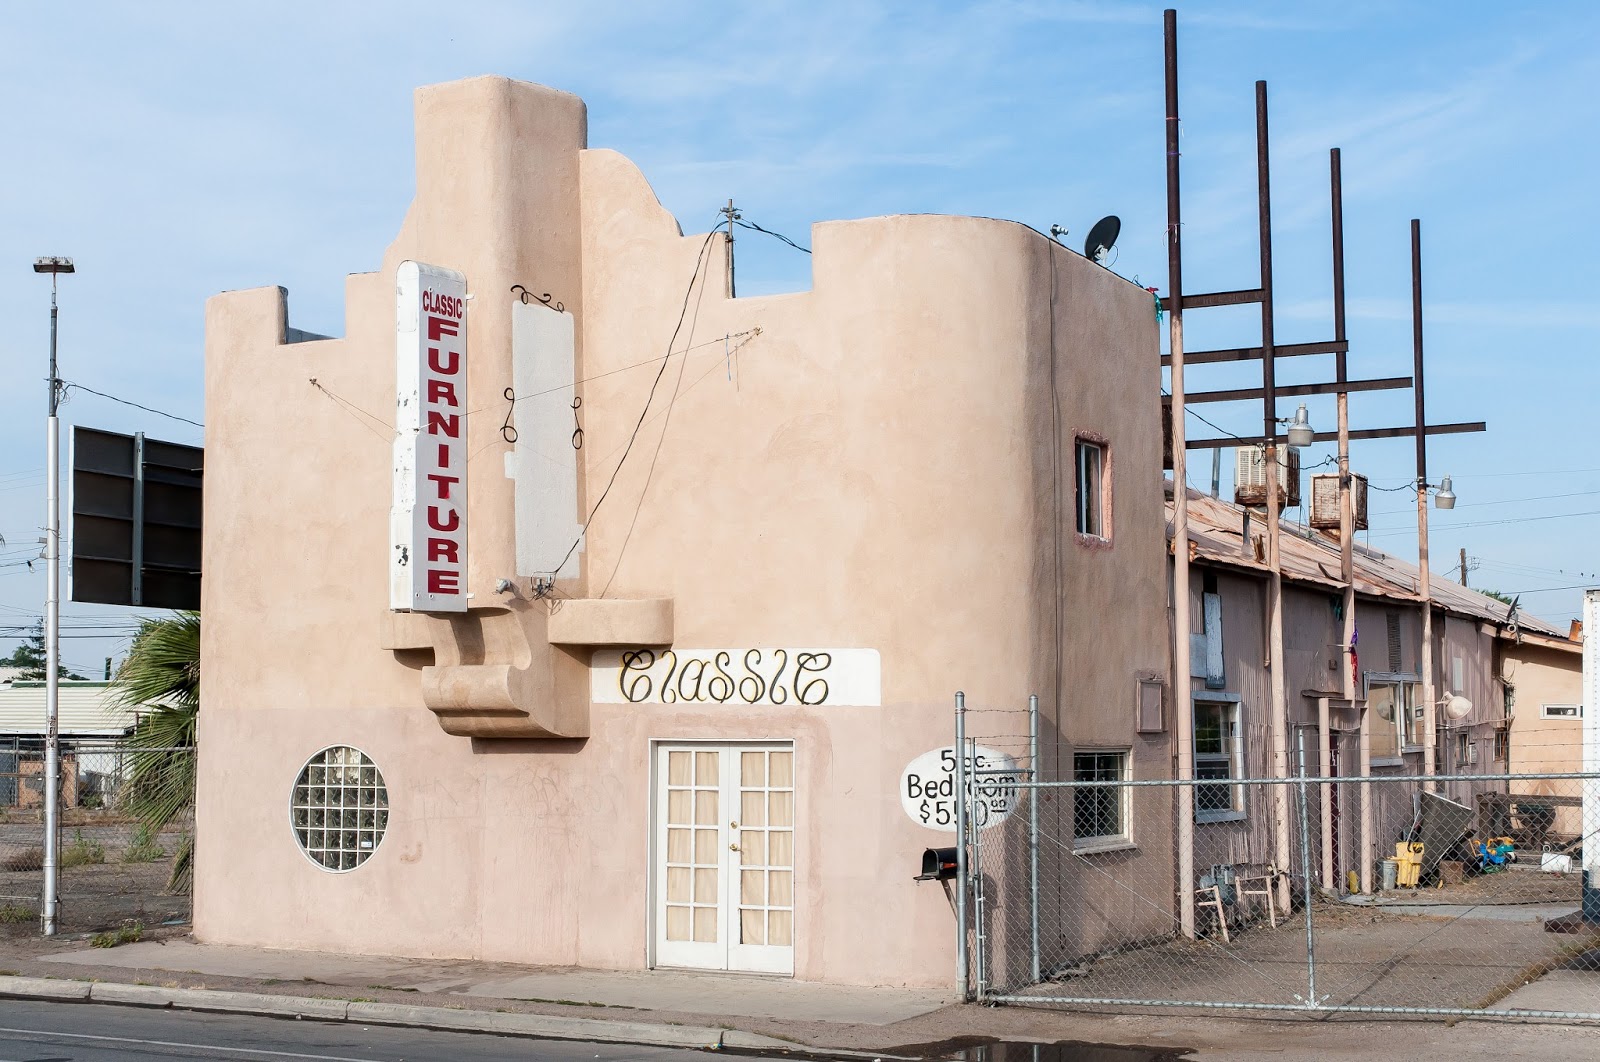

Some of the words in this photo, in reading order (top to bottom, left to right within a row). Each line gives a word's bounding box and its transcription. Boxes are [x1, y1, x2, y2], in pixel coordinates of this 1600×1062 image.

[422, 290, 463, 319] CLASSIC
[427, 316, 460, 594] FURNITURE
[907, 773, 1015, 799] Bedoom
